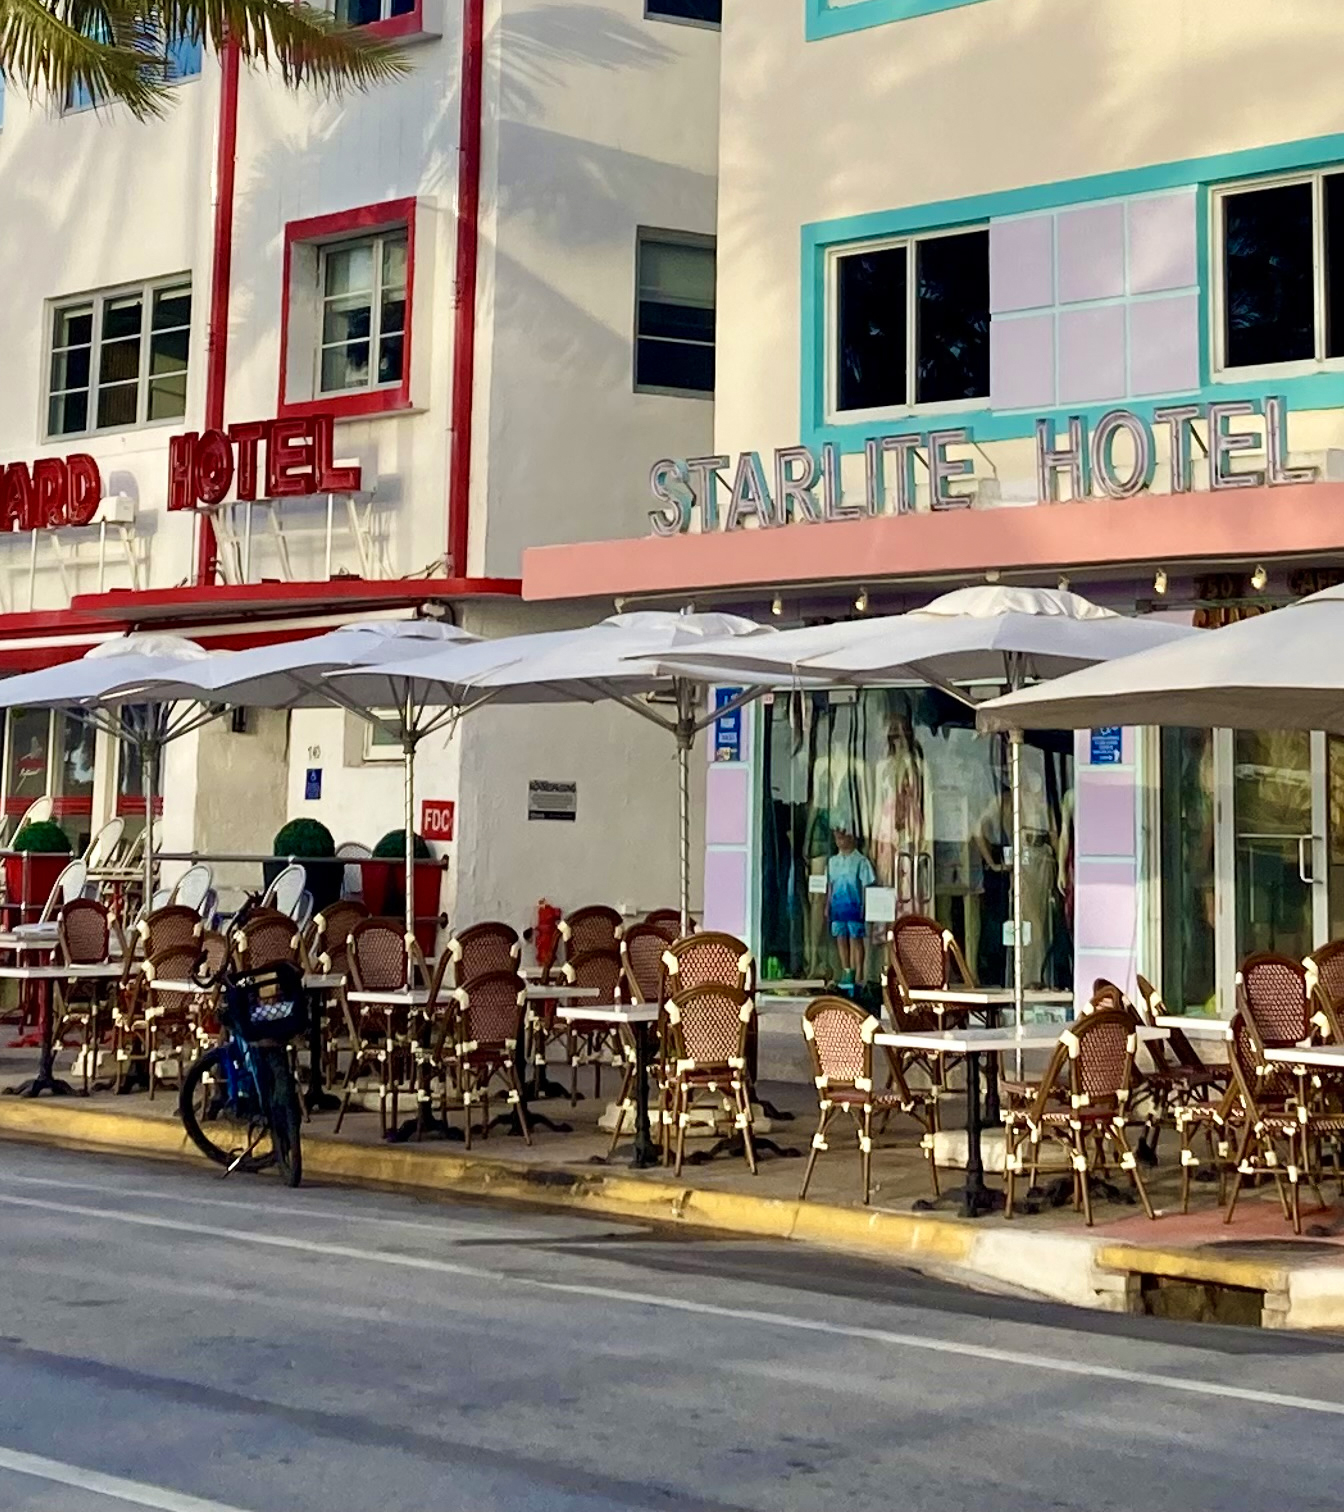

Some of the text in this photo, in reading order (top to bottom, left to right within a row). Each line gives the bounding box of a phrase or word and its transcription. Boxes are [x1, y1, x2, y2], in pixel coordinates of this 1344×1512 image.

[167, 414, 362, 512] HOTEL
[648, 394, 1319, 538] STARLITE HOTEL
[424, 808, 451, 832] FDC
